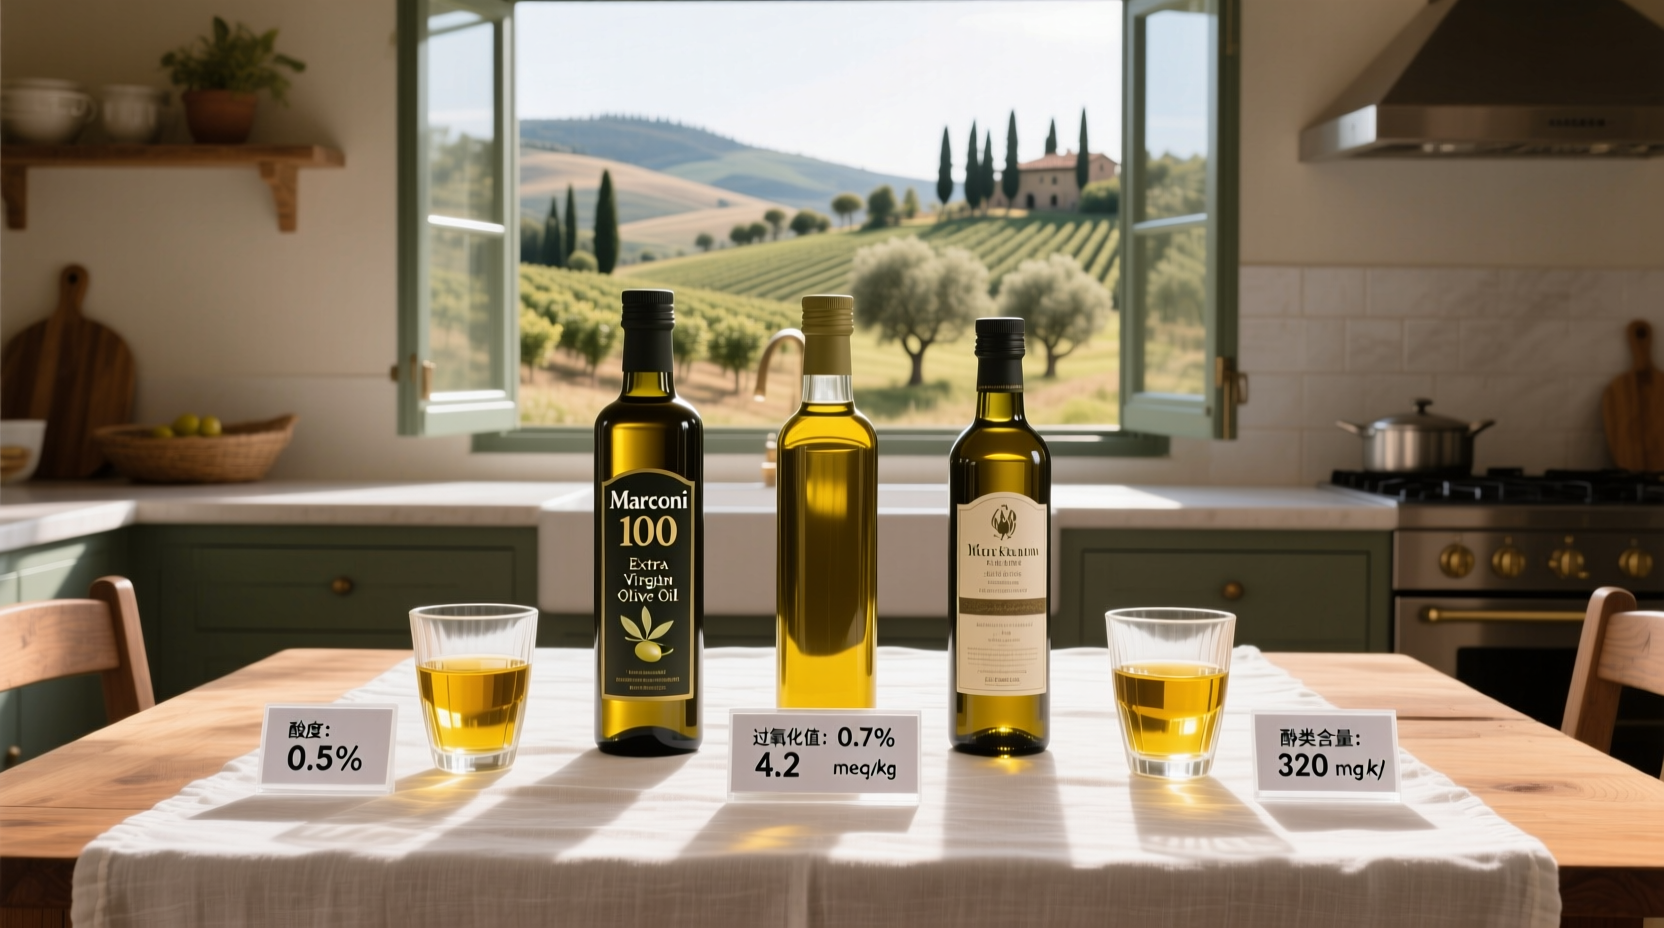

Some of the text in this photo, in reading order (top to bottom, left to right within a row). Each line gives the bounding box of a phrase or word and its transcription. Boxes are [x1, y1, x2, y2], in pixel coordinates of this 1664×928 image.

[609, 490, 688, 510] Marconi
[620, 515, 678, 547] 100
[629, 557, 669, 571] Extra
[617, 588, 679, 603] Olive Oil
[837, 726, 896, 748] 0.7%
[287, 744, 363, 772] 0.5%
[754, 751, 897, 781] 4.2 meq/kg
[1278, 752, 1329, 778] 320
